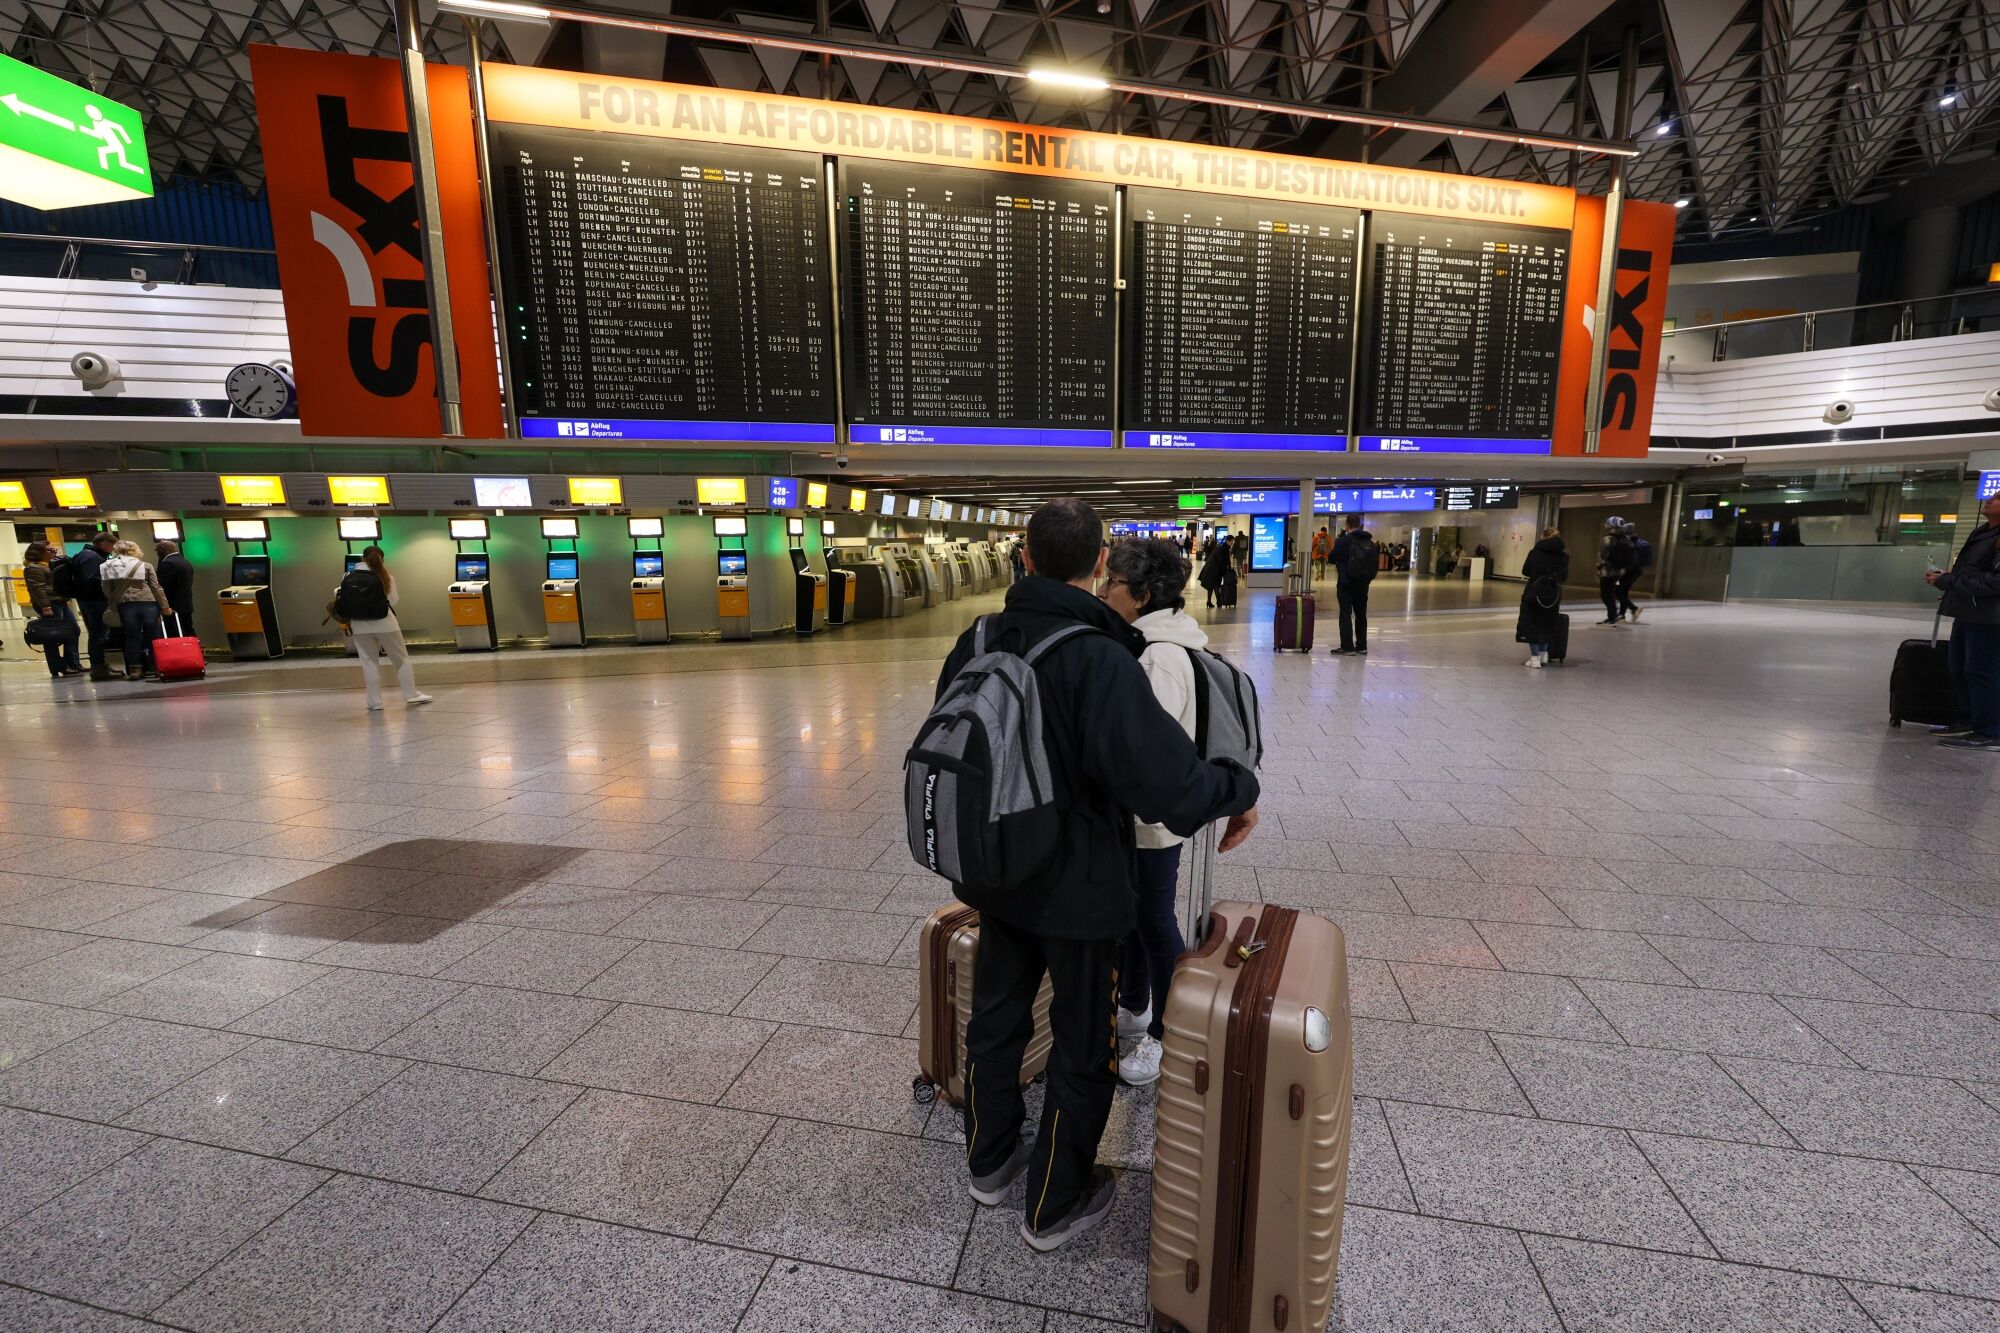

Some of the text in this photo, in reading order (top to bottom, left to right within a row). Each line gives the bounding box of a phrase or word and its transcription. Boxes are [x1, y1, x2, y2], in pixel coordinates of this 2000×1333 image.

[577, 82, 1526, 216] FOR AN AFFORDABLE RENTAL CAR, THE DESTINATION IS SIXT.
[522, 168, 668, 187] LH 1346 WARSCHAU-CANCELLED
[523, 178, 673, 198] LH 126 STUTTGART-CANCELLED
[524, 188, 649, 205] LH 866 OSLO-CANCELLED
[525, 198, 660, 216] LH 924 LONDON-CANCELLED
[907, 202, 925, 210] WIEN
[526, 208, 537, 216] LH
[578, 212, 650, 224] DORTMUND-KOELN
[655, 218, 670, 226] HBF
[527, 218, 538, 226] LH
[579, 222, 610, 231] BREMEN
[528, 228, 652, 244] LH 1212 GENF-CANCELLED
[1184, 227, 1245, 238] LEIPZIG-CANCELLED
[311, 94, 461, 398] SIXT
[529, 238, 540, 246] LH
[581, 241, 672, 254] MUENCHEN-NUERNBERG
[908, 237, 934, 246] AACHEN
[530, 248, 541, 256] LH
[582, 251, 668, 264] ZUERICH-CANCELLED
[558, 269, 574, 277] 174
[584, 270, 665, 282] BERLIN-CANCELLED
[909, 273, 968, 283] PRAG-CANCELLED
[559, 278, 575, 286] 824
[584, 280, 680, 292] KOPENHAGE-CANCELLED
[555, 288, 576, 296] 3430
[585, 289, 611, 298] BASEL
[910, 299, 935, 307] BERLIN
[557, 307, 578, 315] 1120
[587, 308, 613, 317] DELHI
[910, 308, 973, 318] PALMA-CANCELLED
[588, 318, 673, 329] HAMBURG-CANCELLED
[910, 316, 981, 326] MAILAND-CANCELLED
[911, 325, 977, 335] BERLIN-CANCELLED
[911, 342, 978, 351] BREMEN-CANCELLED
[591, 355, 621, 363] BREMEN
[593, 374, 672, 383] KRAKAU-CANCELLED
[594, 383, 634, 391] CHISINAU
[594, 392, 683, 401] BUDAPEST-CANCELLED
[912, 393, 982, 401] HAMBURG-CANCELLED
[595, 401, 664, 410] GRAZ-CANCELLED
[772, 486, 790, 496] 428-
[1330, 492, 1336, 500] B
[772, 497, 786, 506] 499
[1258, 492, 1264, 502] C
